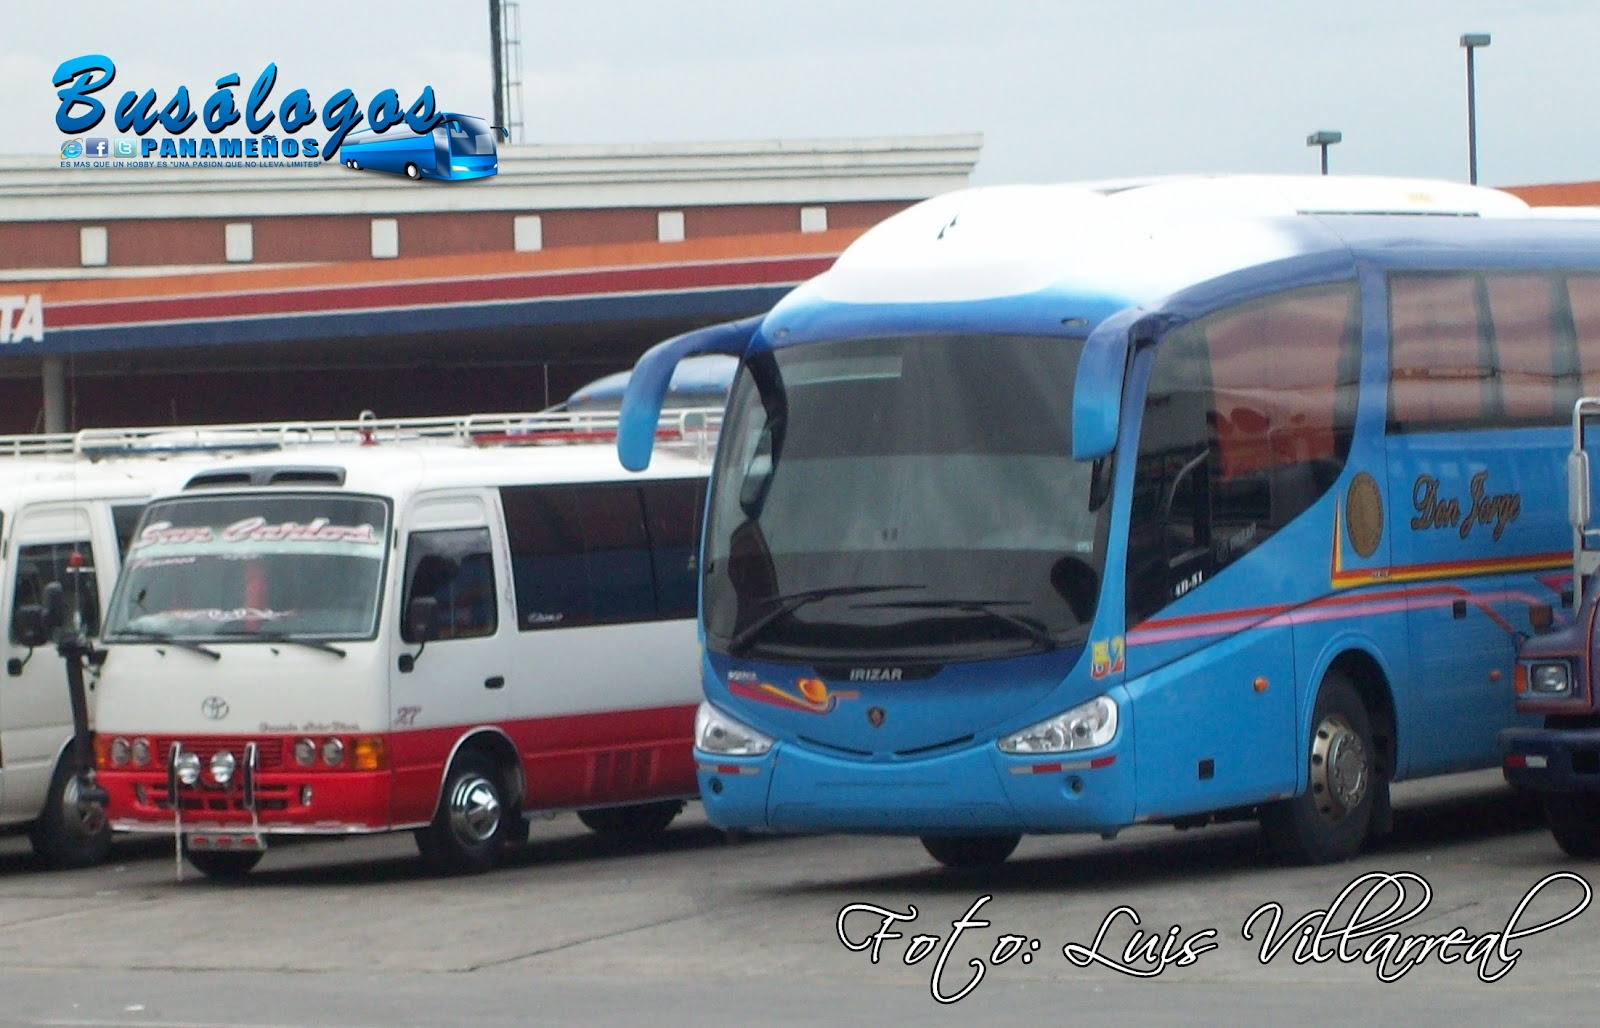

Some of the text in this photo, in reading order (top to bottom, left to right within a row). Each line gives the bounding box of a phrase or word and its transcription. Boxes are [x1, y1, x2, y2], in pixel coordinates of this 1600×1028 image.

[1411, 471, 1521, 541] Don Jorge
[850, 667, 903, 681] IRIZAR
[1091, 636, 1125, 680] 52
